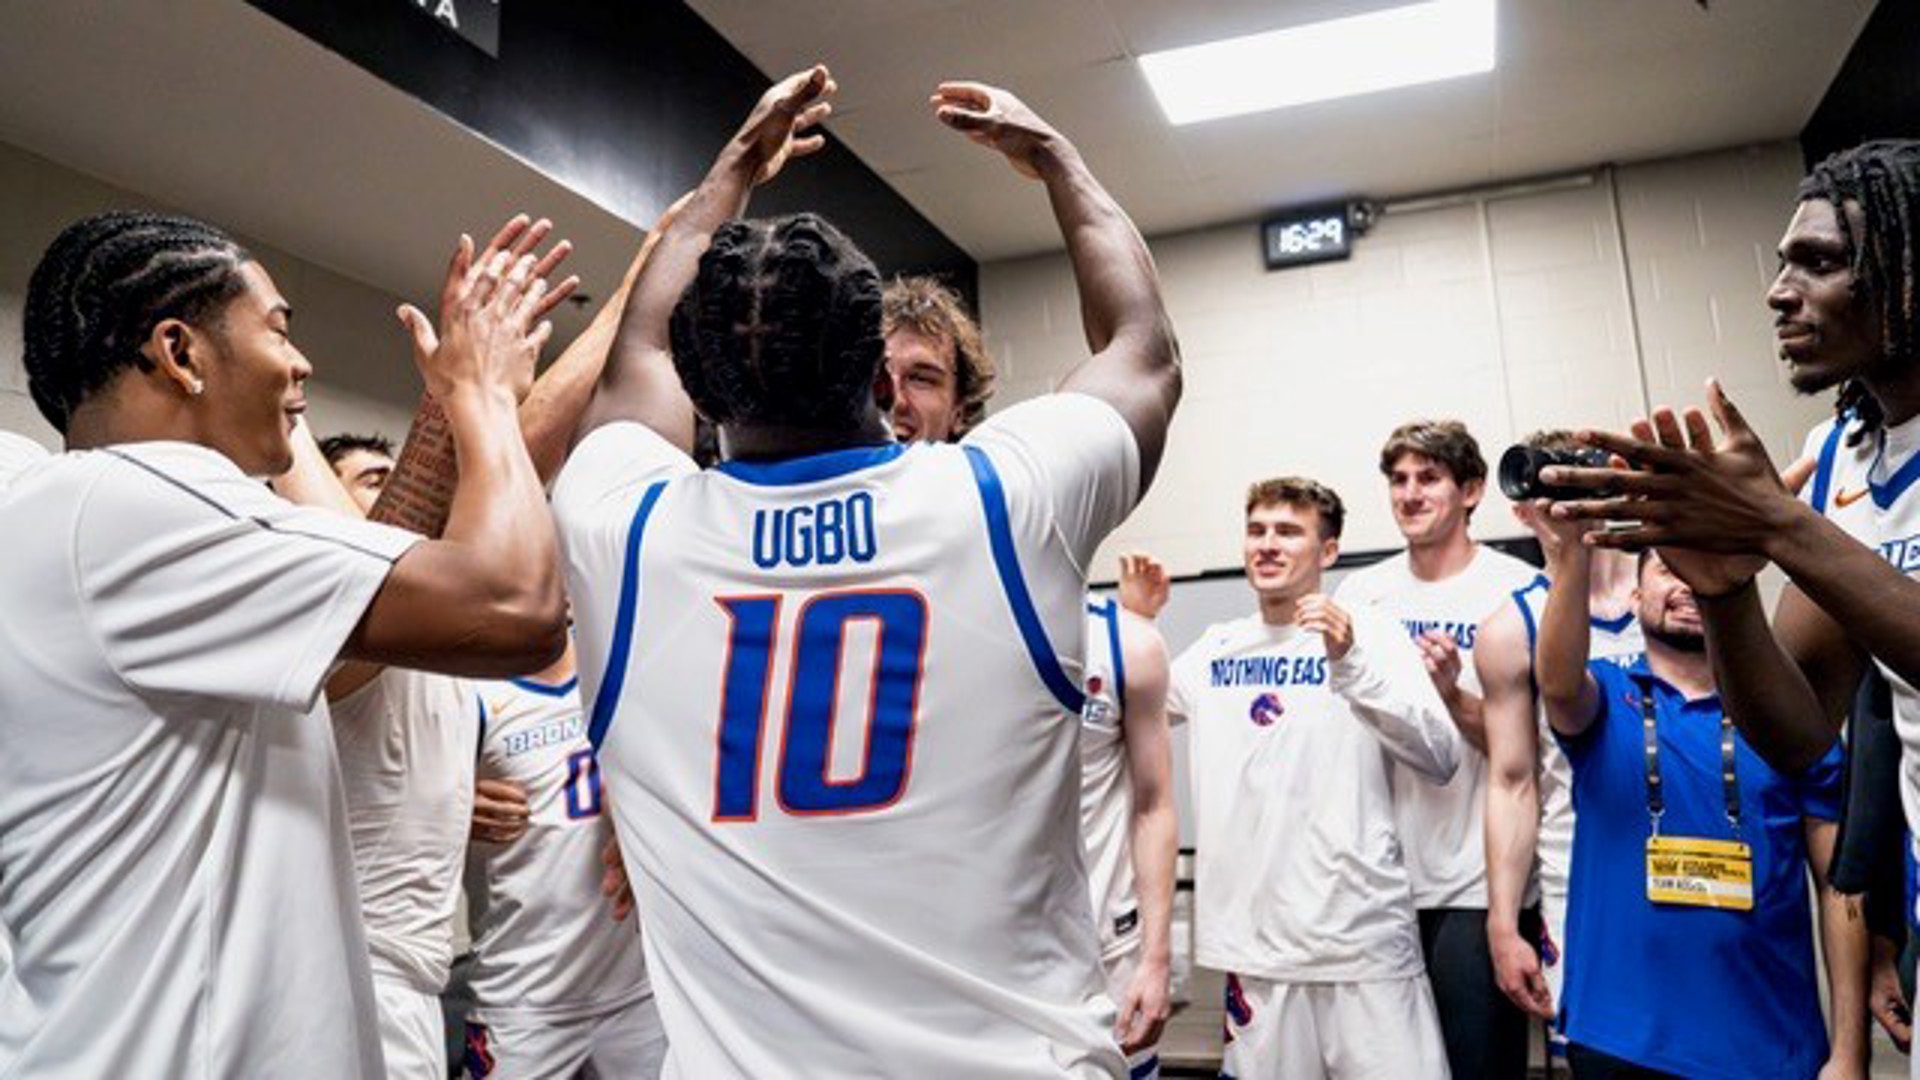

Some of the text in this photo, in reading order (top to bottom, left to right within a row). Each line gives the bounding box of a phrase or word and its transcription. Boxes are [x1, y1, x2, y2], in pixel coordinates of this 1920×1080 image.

[753, 491, 876, 568] UGBO
[711, 588, 930, 822] 10
[1211, 657, 1288, 687] NOTHING
